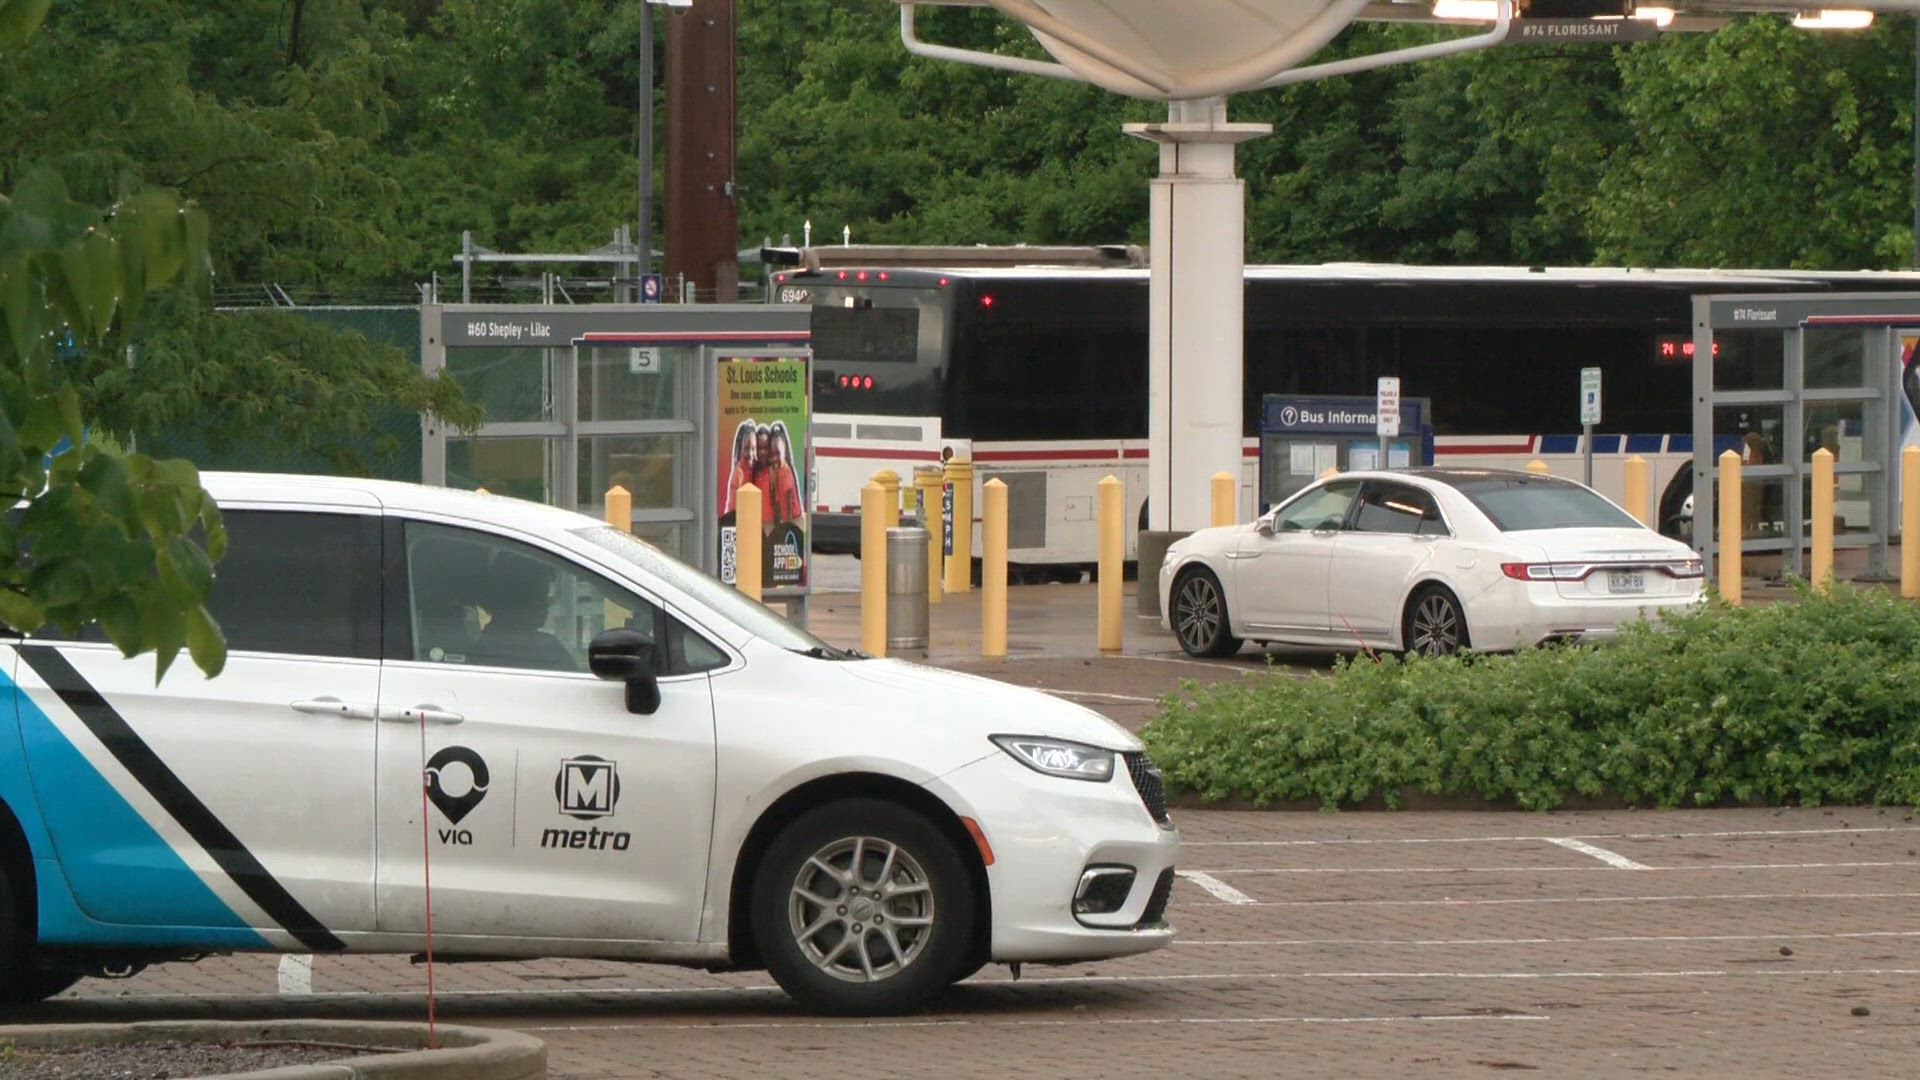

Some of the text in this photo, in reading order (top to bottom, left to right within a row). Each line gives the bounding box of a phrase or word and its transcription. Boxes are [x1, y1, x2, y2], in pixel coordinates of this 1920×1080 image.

[1523, 24, 1619, 36] #74 FLORISSANT
[1733, 309, 1777, 320] #74 Florissant
[467, 321, 487, 337] #60
[488, 321, 523, 340] Shepley
[530, 321, 551, 337] Lilac
[638, 351, 651, 367] 5
[727, 366, 797, 384] St. Louis Schools
[1300, 411, 1324, 422] Bus
[774, 544, 795, 556] SCHOOL
[438, 829, 472, 845] via
[541, 827, 630, 851] metro
